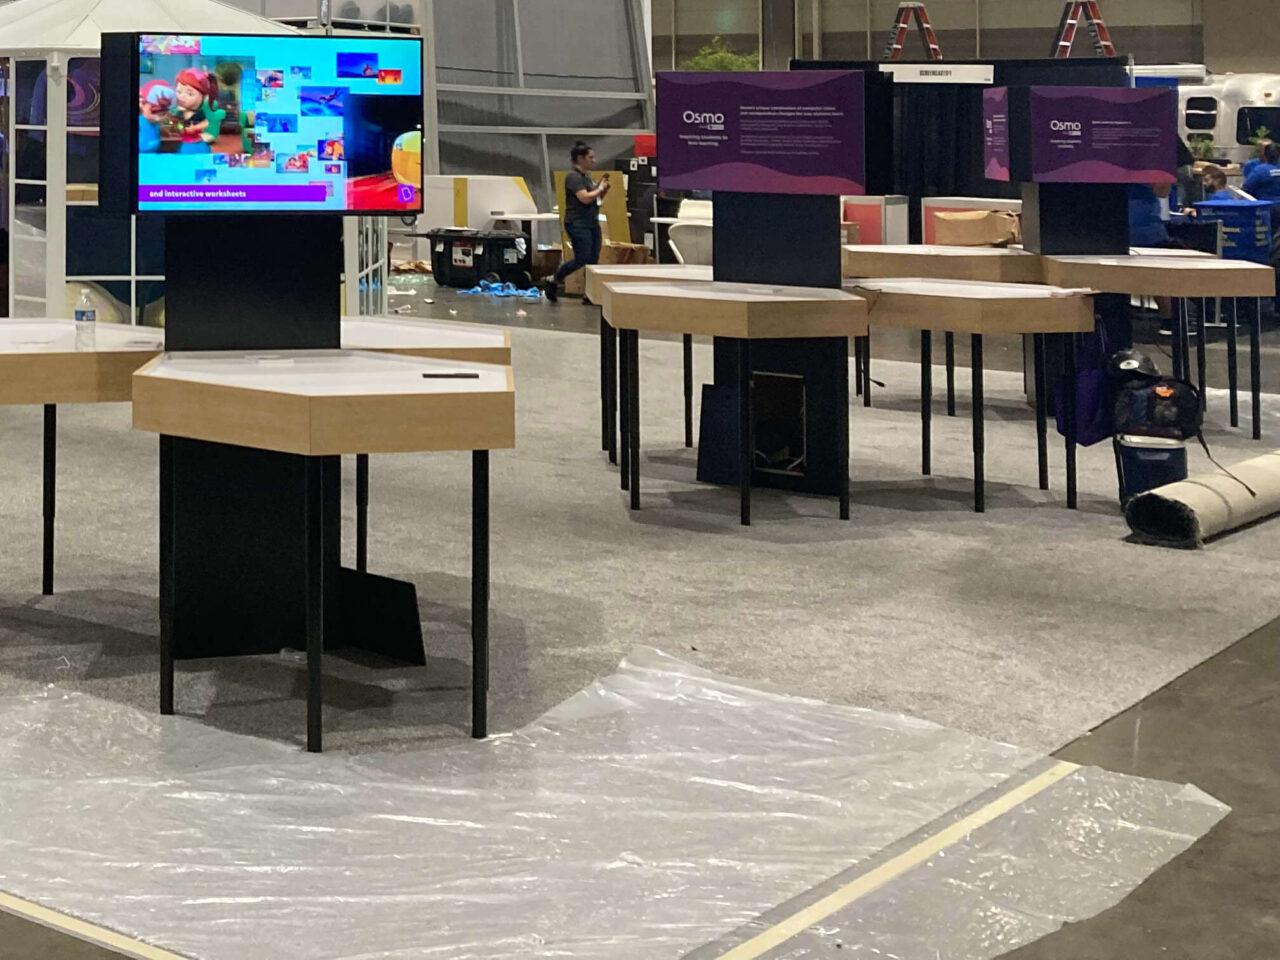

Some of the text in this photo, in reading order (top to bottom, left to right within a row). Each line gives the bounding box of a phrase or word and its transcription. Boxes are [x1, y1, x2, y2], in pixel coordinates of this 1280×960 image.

[682, 110, 725, 124] Osmo
[1050, 120, 1082, 131] Osmo
[149, 189, 247, 198] and interactive worksheets
